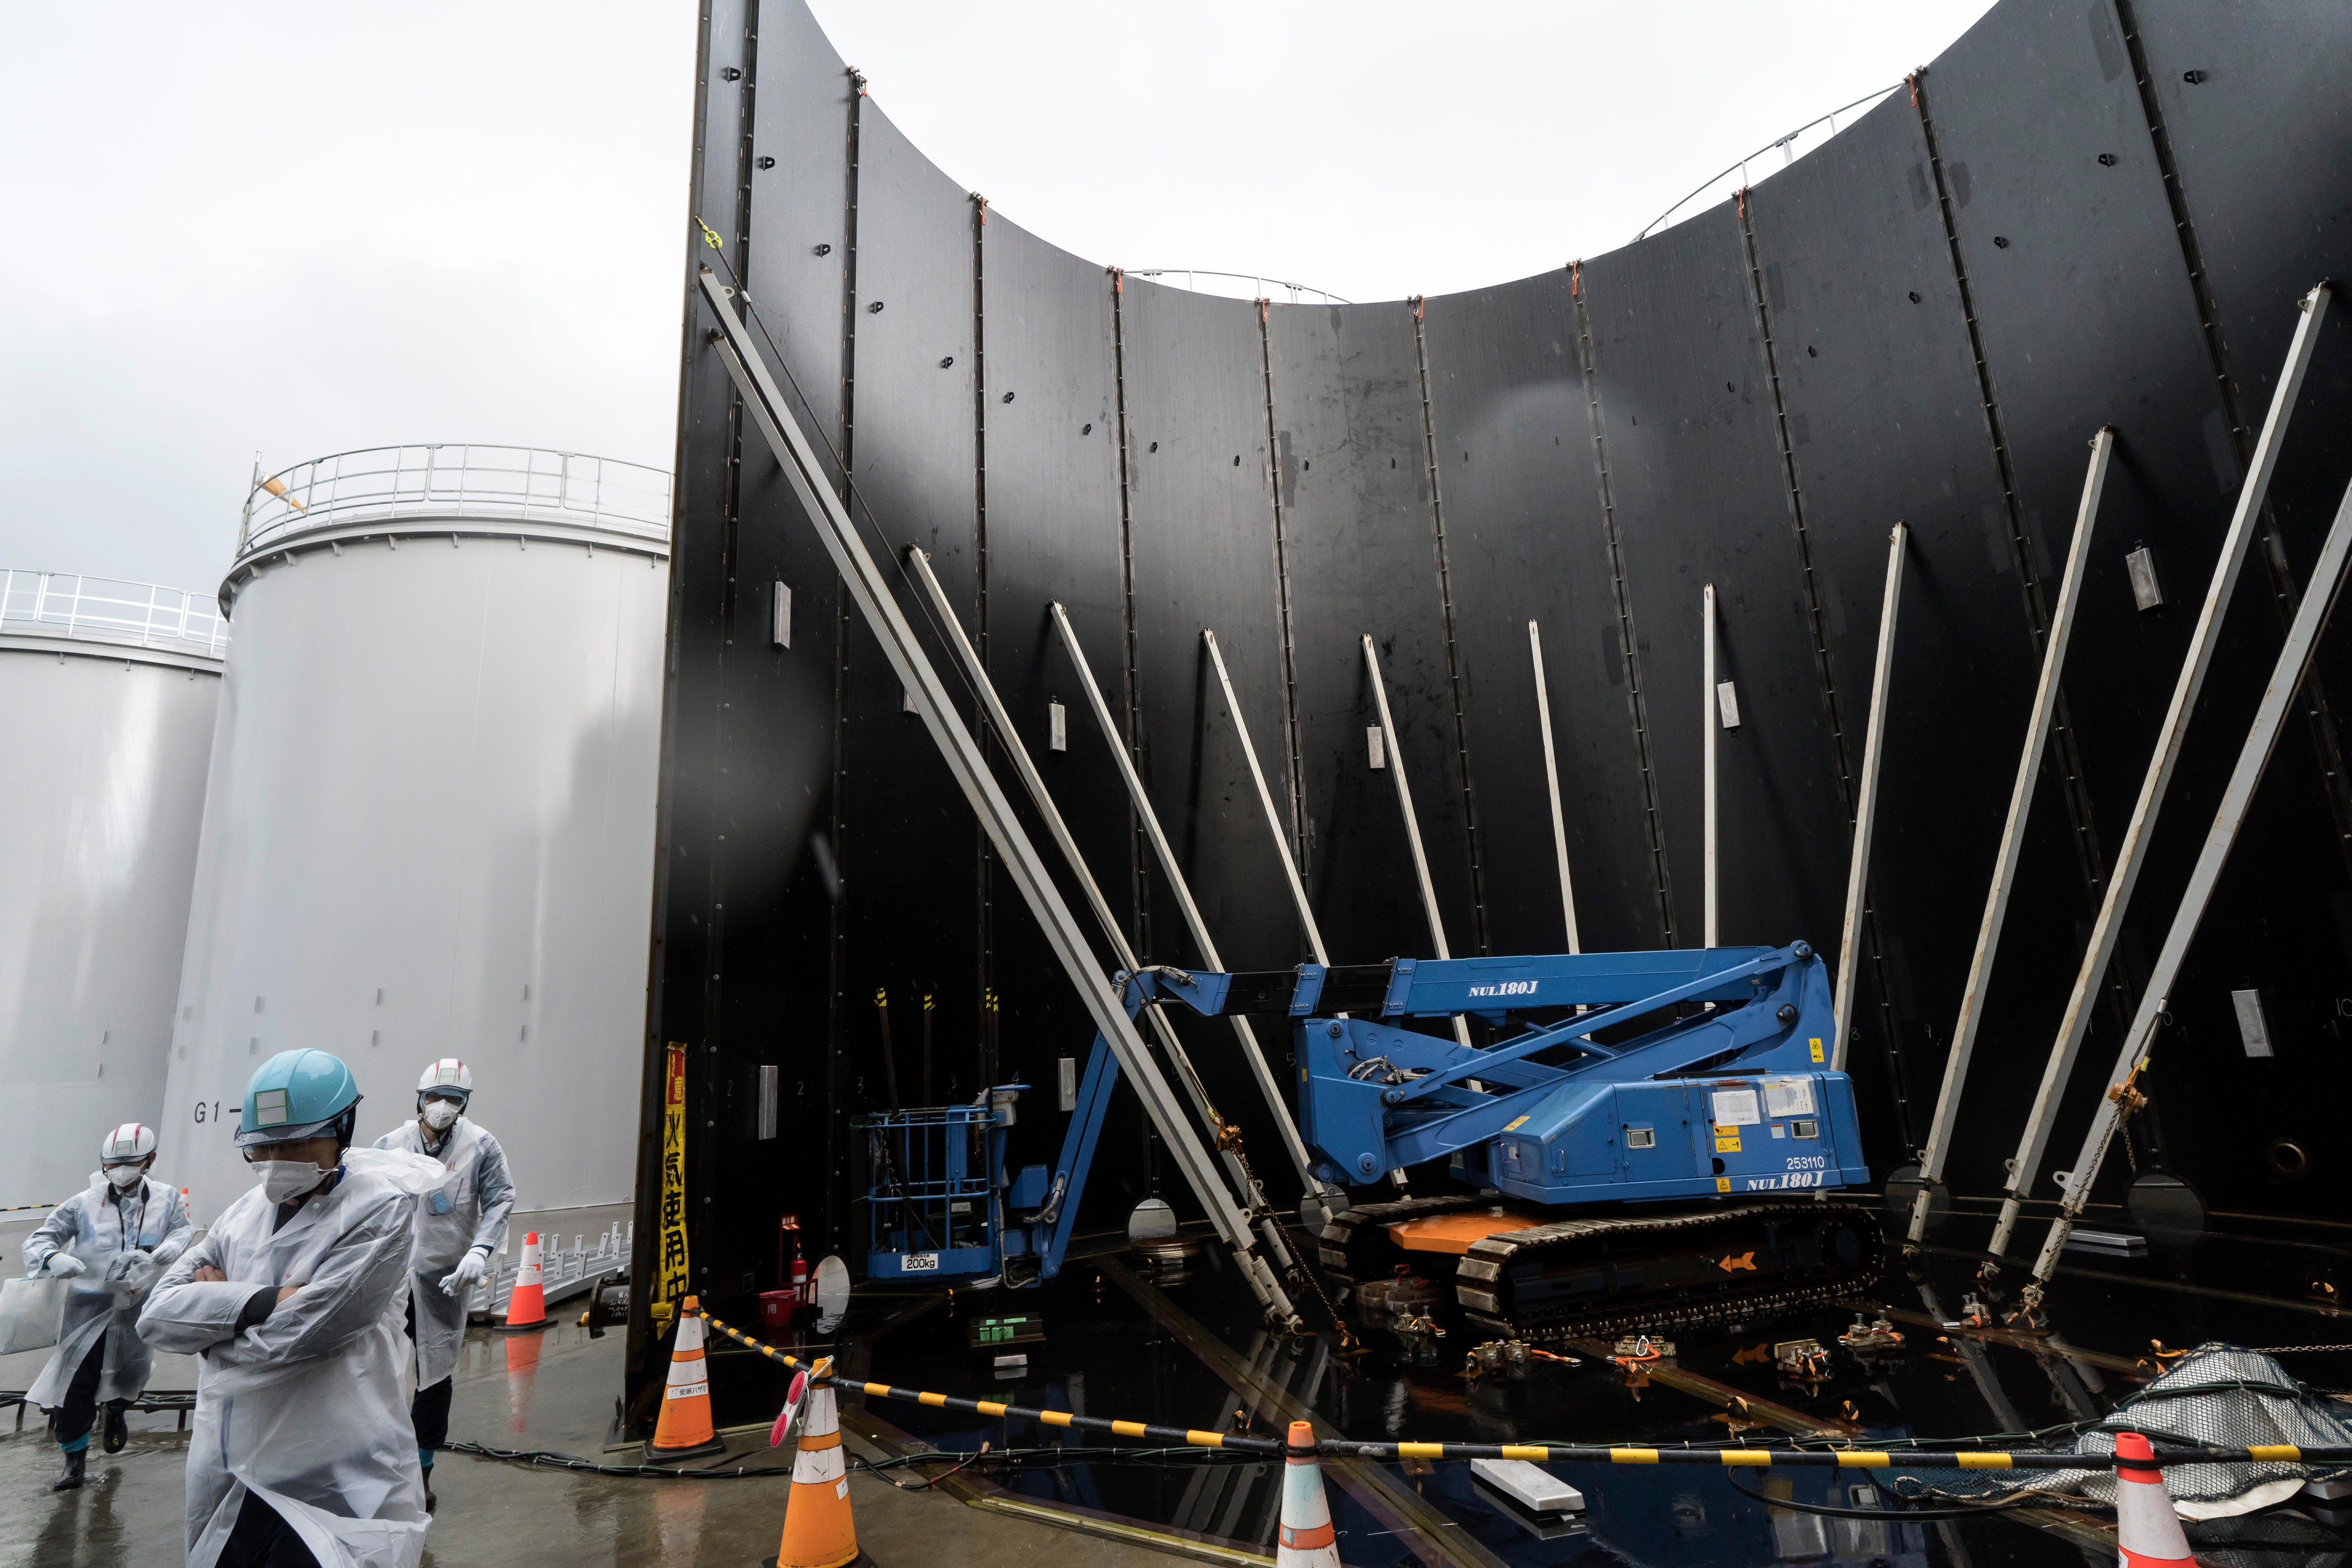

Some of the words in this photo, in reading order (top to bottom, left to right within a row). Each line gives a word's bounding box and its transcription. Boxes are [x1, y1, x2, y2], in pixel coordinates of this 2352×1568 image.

[1468, 980, 1539, 997] NUL180J
[1850, 1027, 1860, 1041] 8
[1286, 1052, 1296, 1067] 5
[727, 1080, 733, 1097] 2
[797, 1081, 804, 1095] 2
[858, 1076, 864, 1094] 3
[949, 1075, 956, 1089] 3
[1786, 1155, 1825, 1170] 253110
[1747, 1171, 1825, 1191] NUL180J
[664, 1110, 687, 1304] 火気使用中
[906, 1258, 935, 1269] 200kg
[679, 1385, 707, 1396] 安藤ハザマ
